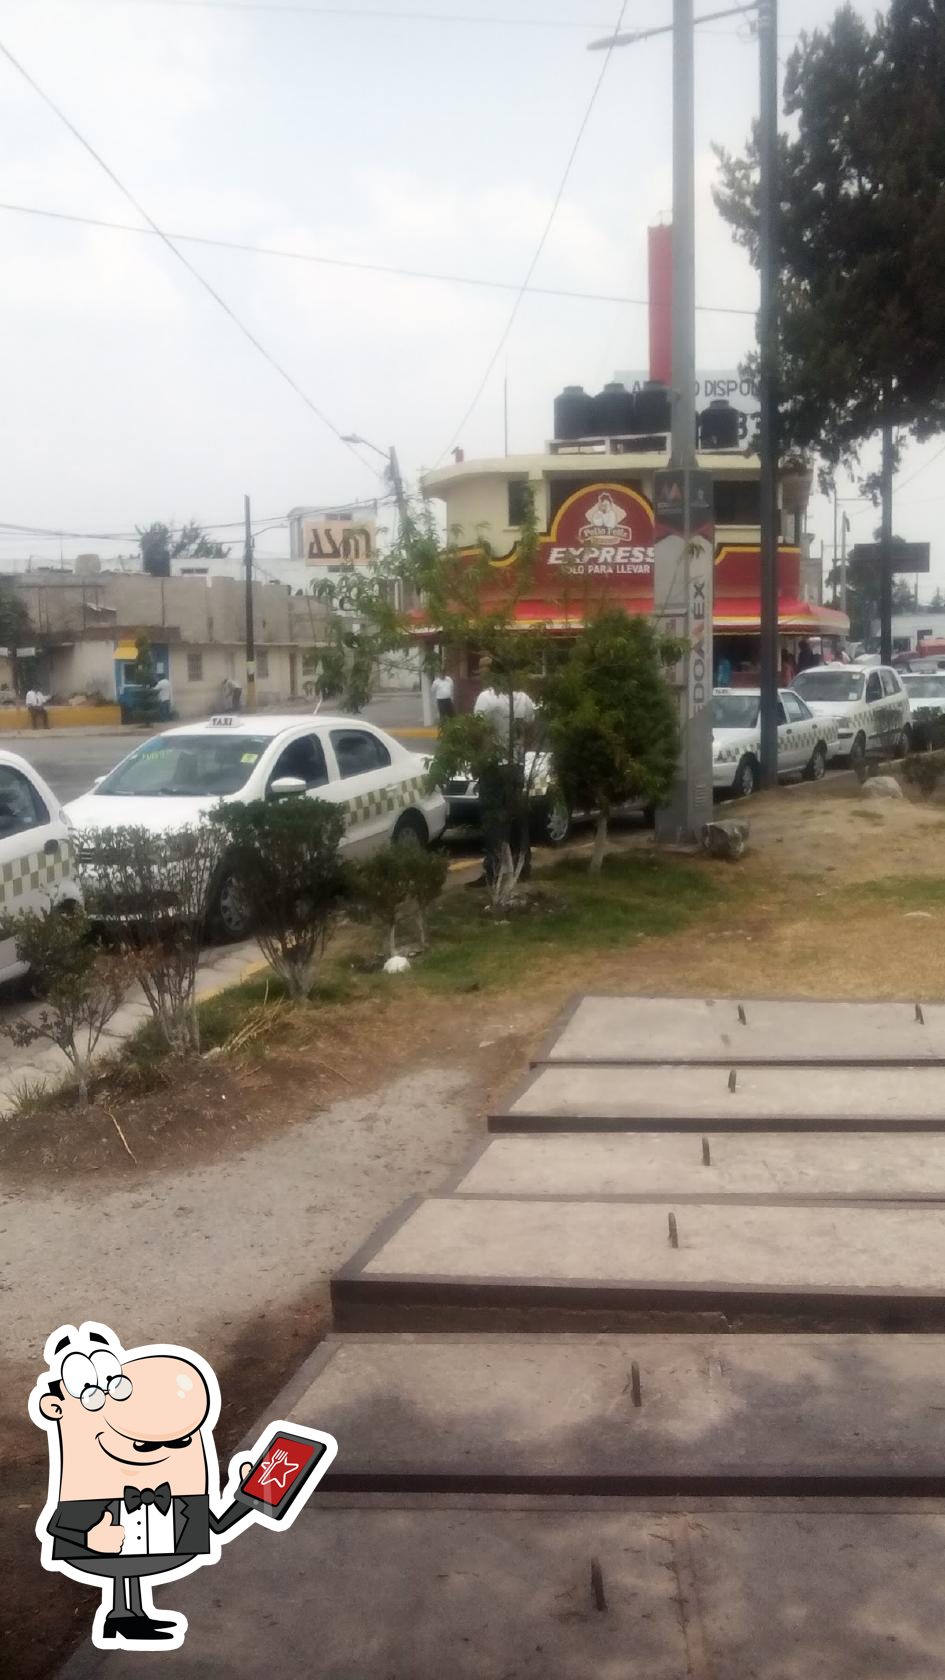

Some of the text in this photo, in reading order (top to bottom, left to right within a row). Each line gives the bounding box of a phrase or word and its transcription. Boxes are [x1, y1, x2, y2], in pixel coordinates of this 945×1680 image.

[704, 379, 761, 397] DISPON
[587, 565, 614, 574] PARA
[616, 564, 651, 574] LLEVAR
[212, 717, 233, 727] TAXI
